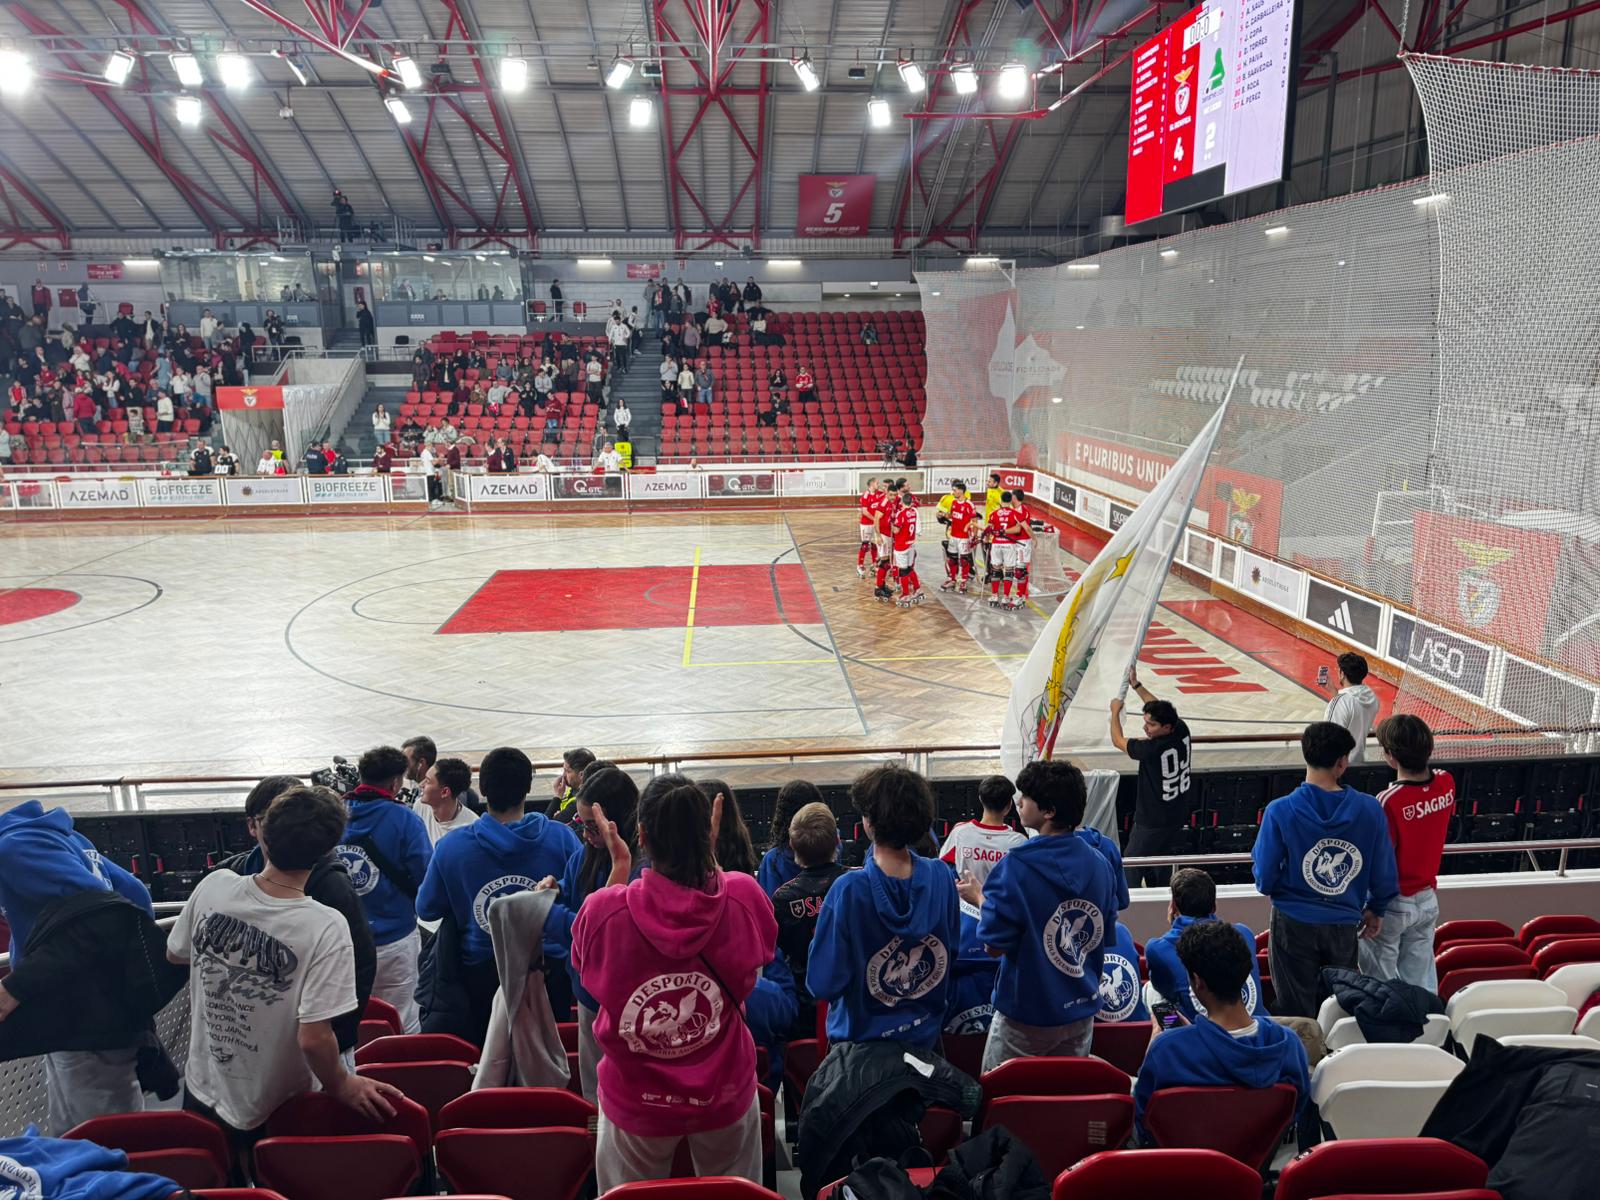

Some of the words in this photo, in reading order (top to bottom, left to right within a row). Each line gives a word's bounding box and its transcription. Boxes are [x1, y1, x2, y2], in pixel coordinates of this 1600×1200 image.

[1205, 121, 1217, 150] 2
[1174, 137, 1184, 161] 4
[824, 202, 846, 224] 5
[1076, 442, 1081, 460] E
[1083, 444, 1134, 476] PLURIBUS
[481, 484, 538, 495] AZEMAD
[938, 478, 977, 486] AZAD
[1005, 476, 1026, 487] CIN
[70, 488, 129, 502] AZEMAD
[909, 523, 915, 536] 9
[1162, 767, 1191, 802] 56
[1416, 788, 1454, 819] SAGRES
[974, 847, 1006, 862] SAGR
[1312, 840, 1356, 856] DESPORTO
[632, 974, 711, 1007] DESPORTO
